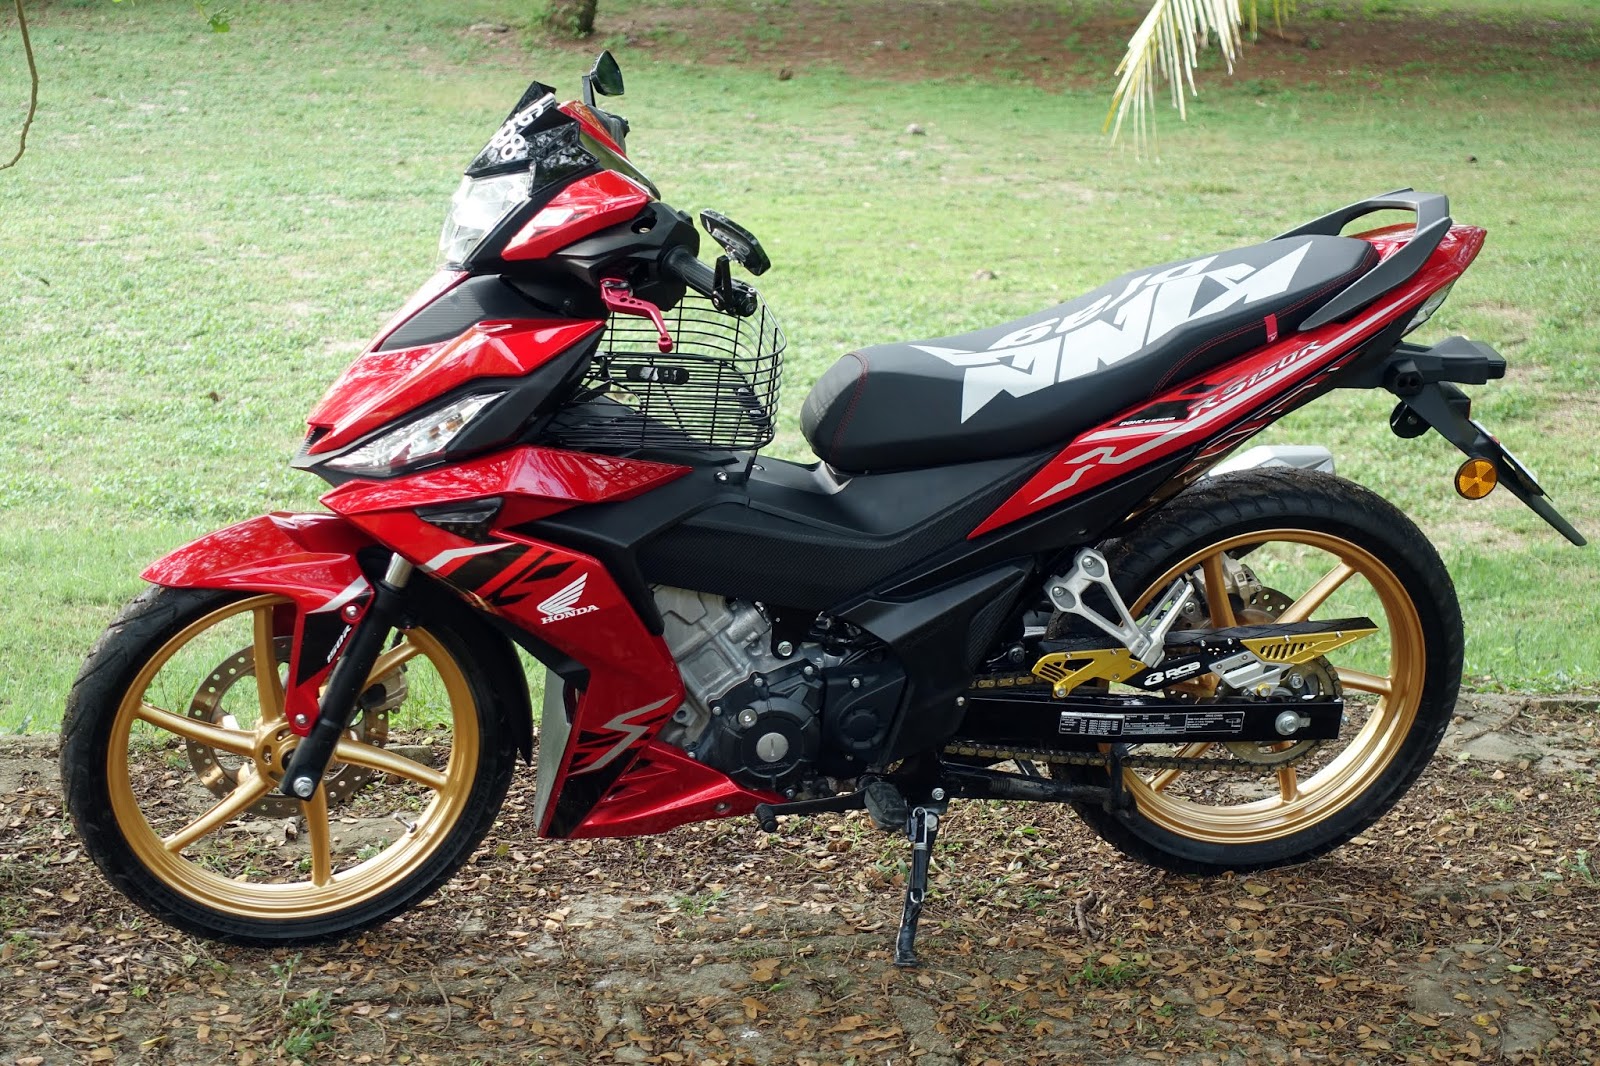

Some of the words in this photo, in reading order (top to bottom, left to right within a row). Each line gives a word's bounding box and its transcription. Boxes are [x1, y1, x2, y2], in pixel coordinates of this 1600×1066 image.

[1186, 340, 1322, 420] RS150R
[540, 604, 600, 625] HONDA
[1165, 661, 1201, 679] RCB
